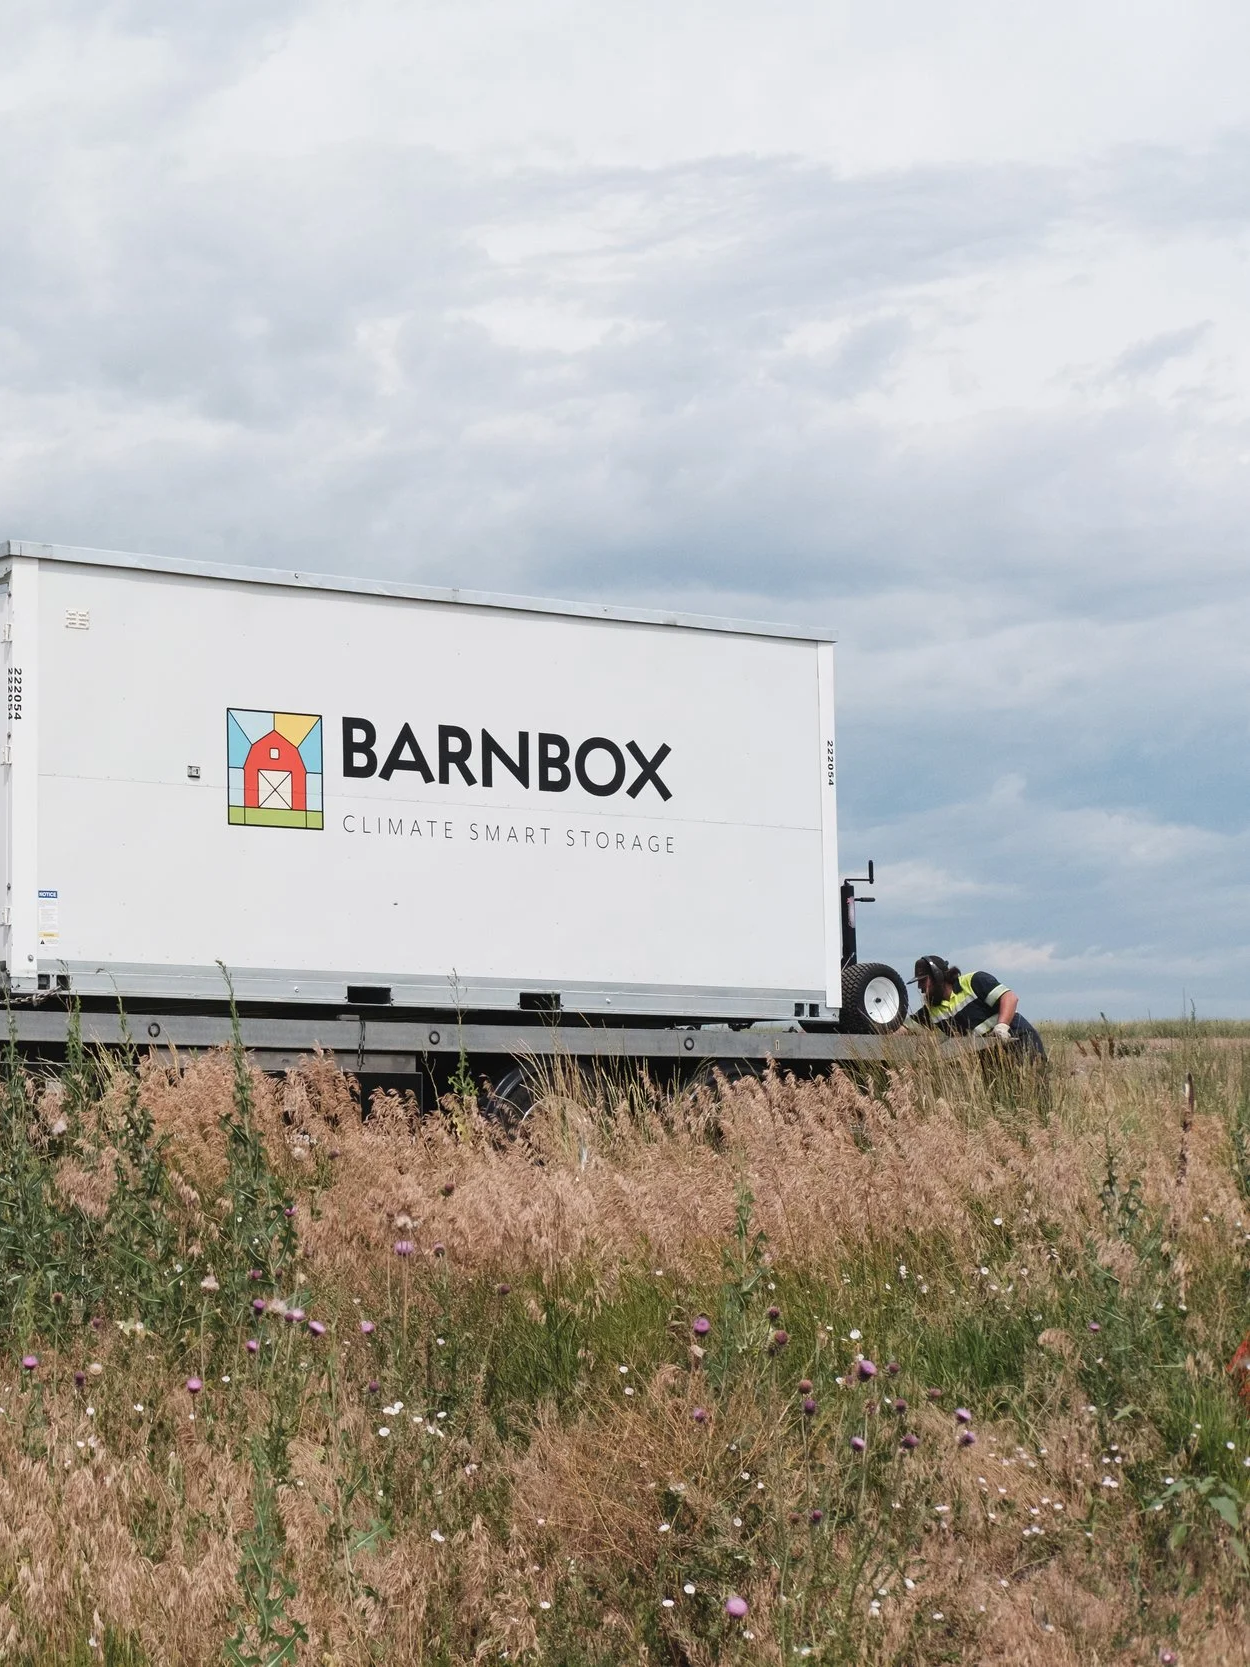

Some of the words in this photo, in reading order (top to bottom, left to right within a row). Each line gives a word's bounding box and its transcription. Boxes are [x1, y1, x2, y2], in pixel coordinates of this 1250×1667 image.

[13, 667, 22, 720] 222054
[342, 716, 673, 802] BARNBOX
[827, 740, 835, 786] 222054
[342, 814, 454, 840] CLIMATE
[469, 822, 551, 846] SMART
[565, 829, 675, 854] STORAGE
